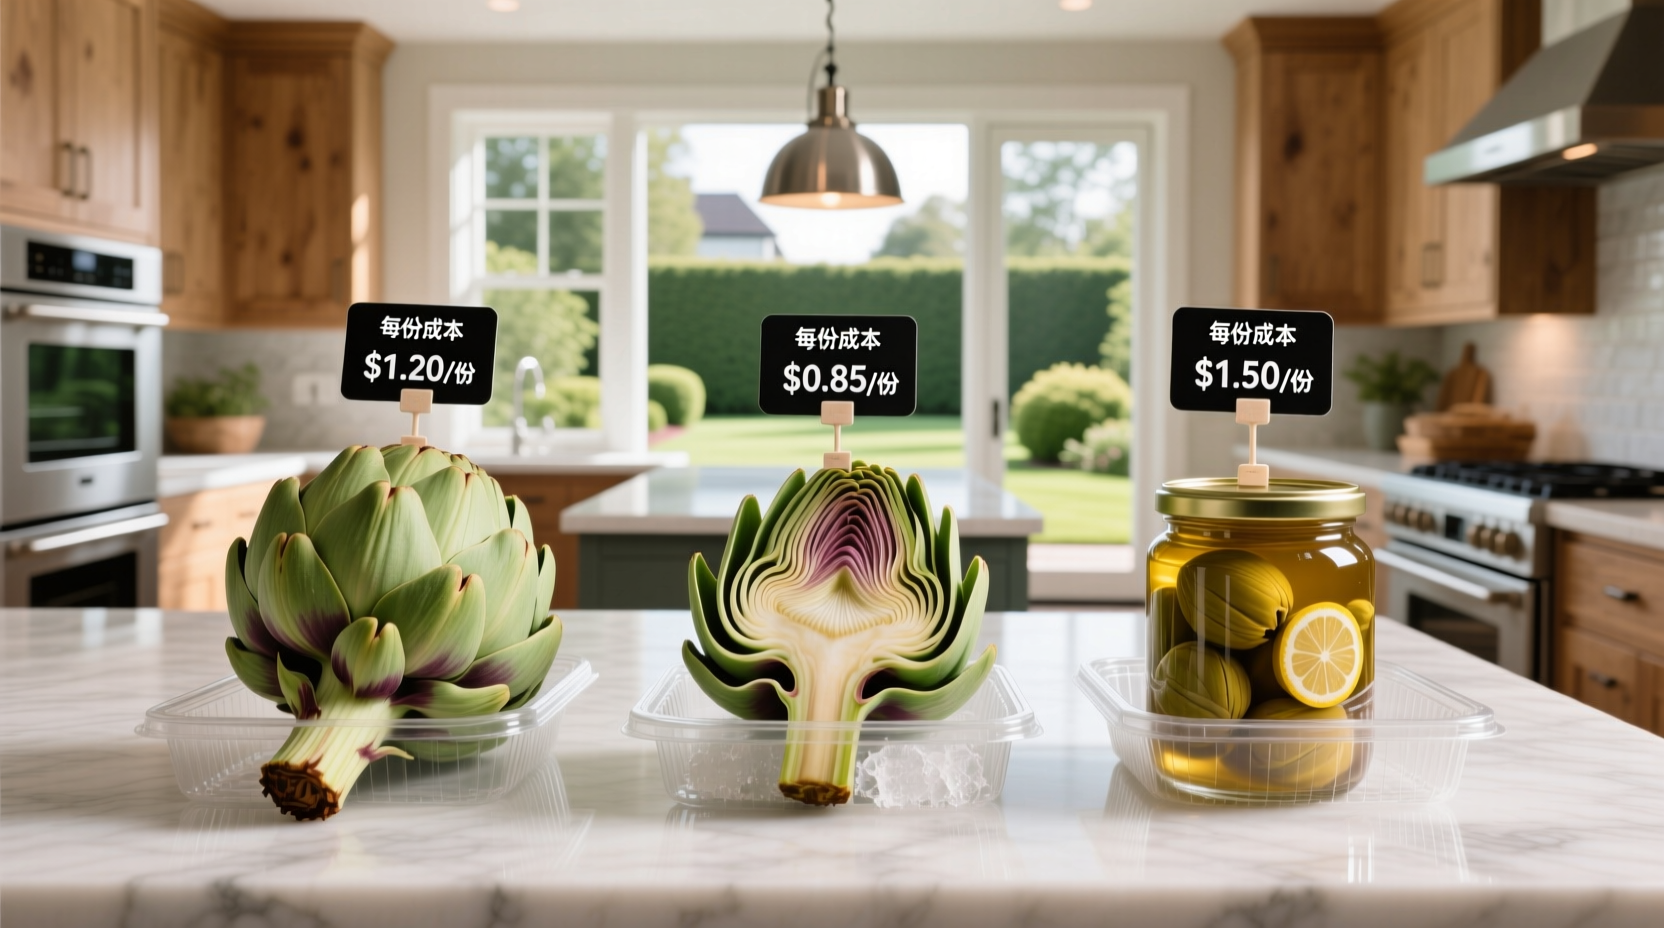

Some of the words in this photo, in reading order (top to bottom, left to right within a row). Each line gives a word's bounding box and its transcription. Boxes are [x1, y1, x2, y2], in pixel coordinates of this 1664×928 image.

[380, 316, 463, 341] 每份成本
[795, 327, 881, 350] 每份成本
[1209, 320, 1296, 347] 每份成本
[363, 350, 475, 384] $1.20/份
[783, 361, 899, 396] $0.85/份
[1195, 356, 1314, 393] $1.50/份
